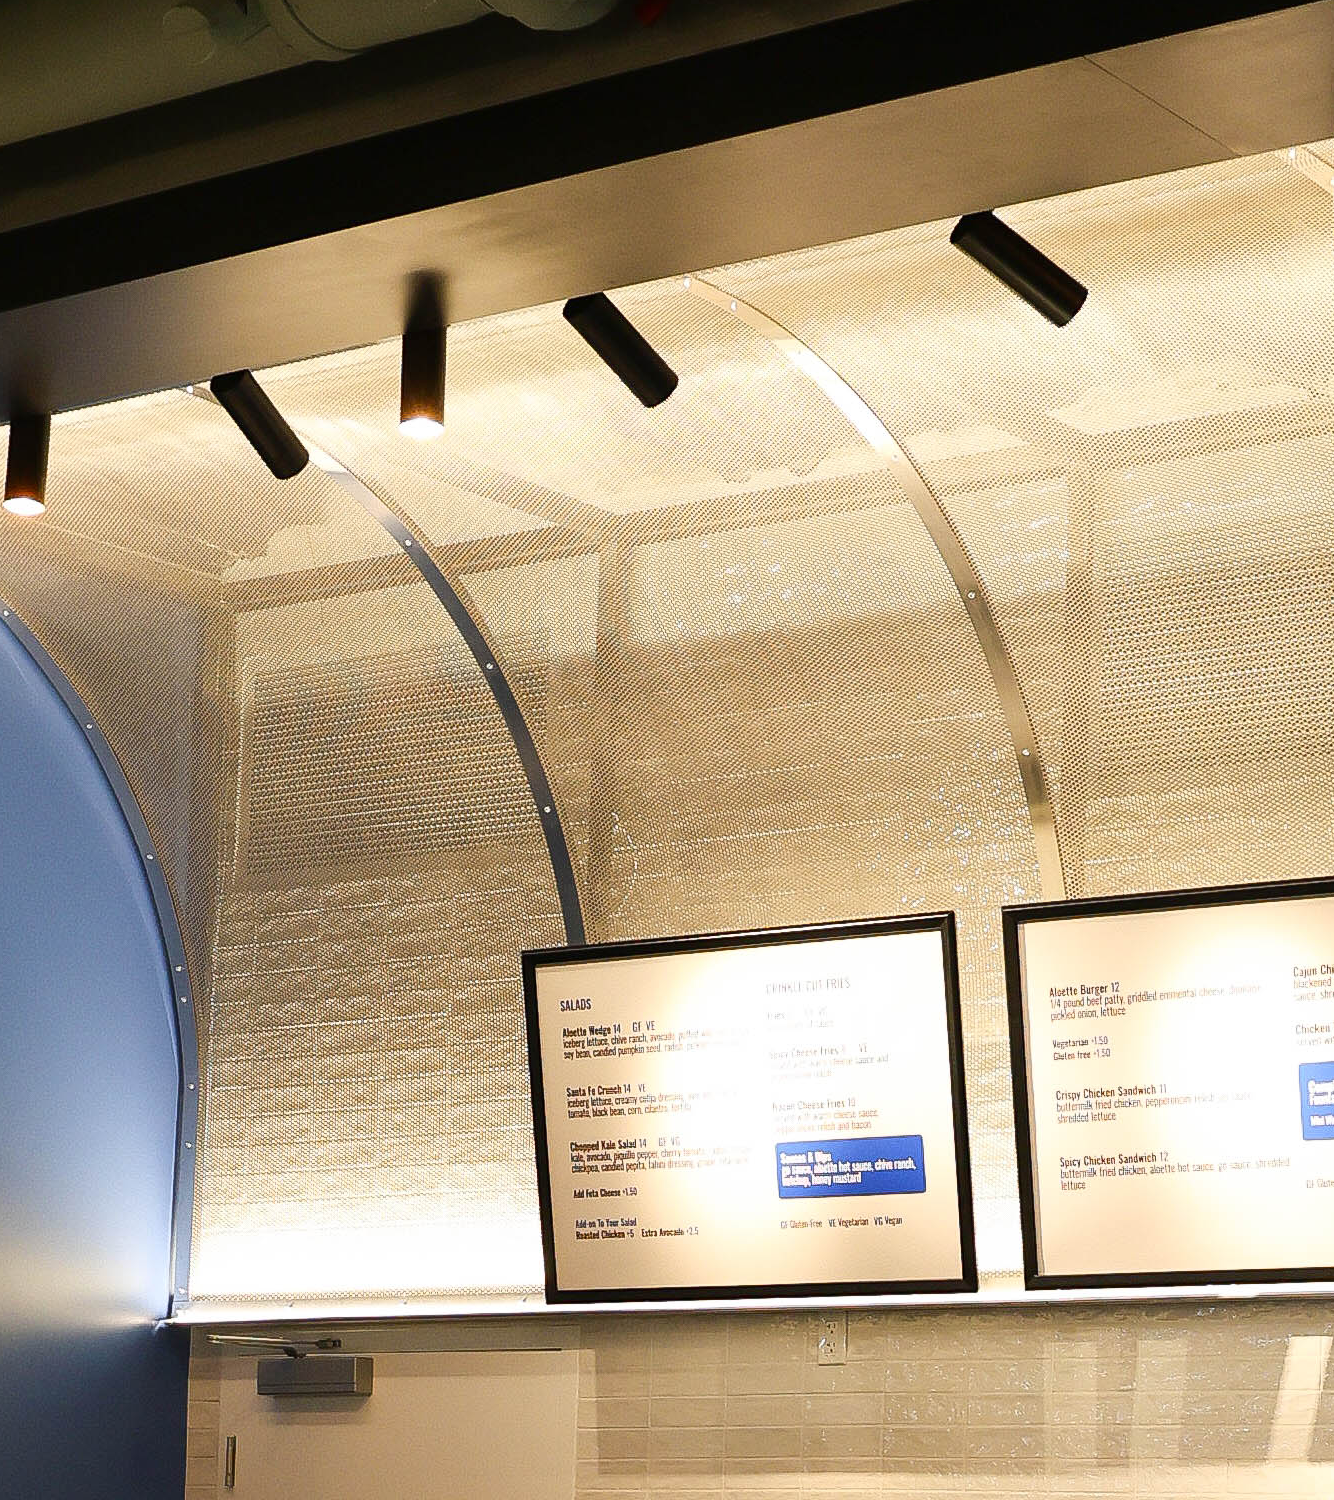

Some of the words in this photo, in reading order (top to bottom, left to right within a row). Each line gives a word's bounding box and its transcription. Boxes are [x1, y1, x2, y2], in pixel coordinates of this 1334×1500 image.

[1293, 966, 1318, 979] Cajun
[1049, 985, 1078, 998] Aloette
[1080, 984, 1108, 997] Burger
[1111, 981, 1120, 993] 12
[560, 998, 592, 1012] SALADS
[1063, 996, 1085, 1009] pound
[1127, 990, 1157, 1006] griddled
[1050, 1007, 1076, 1022] pickled
[1077, 1008, 1099, 1019] onion,
[1100, 1006, 1127, 1018] lettuce
[612, 1023, 621, 1034] 14
[645, 1020, 656, 1031] VE
[1295, 1023, 1331, 1035] Chicken
[563, 1037, 585, 1049] iceberg
[610, 1033, 628, 1045] chive
[1052, 1037, 1089, 1050] Vegetarian
[567, 1087, 586, 1097] Santa
[623, 1083, 631, 1094] 14
[1055, 1089, 1081, 1102] Crispy
[1083, 1087, 1115, 1099] Chicken
[1117, 1084, 1156, 1097] Sandwich
[1159, 1083, 1167, 1094] 11
[1095, 1099, 1112, 1110] fried
[1057, 1113, 1089, 1124] shredded
[1091, 1111, 1117, 1123] lettuce
[601, 1139, 616, 1150] Kale
[618, 1138, 637, 1149] Salad
[639, 1138, 647, 1148] 14
[838, 1161, 851, 1173] hot
[874, 1158, 893, 1171] chive
[893, 1156, 917, 1170] ranch,
[1059, 1156, 1081, 1169] Spicy
[1083, 1153, 1116, 1167] Chicken
[1118, 1152, 1157, 1165] Sandwich
[1159, 1151, 1169, 1163] 12
[1099, 1166, 1117, 1177] fried
[1177, 1162, 1190, 1173] hot
[1060, 1180, 1086, 1192] lettuce
[573, 1189, 584, 1199] Add
[586, 1188, 600, 1198] Feta
[600, 1187, 621, 1198] Cheese
[576, 1218, 597, 1229] Add-on
[597, 1218, 605, 1227] To
[606, 1218, 619, 1227] Your
[620, 1217, 637, 1226] Salad
[828, 1218, 837, 1228] VE
[838, 1217, 869, 1228] Vegetarian
[874, 1216, 883, 1226] VG
[884, 1215, 903, 1227] Vegan
[576, 1229, 600, 1240] Roasted
[601, 1228, 626, 1239] Chicken
[641, 1227, 658, 1238] Extra
